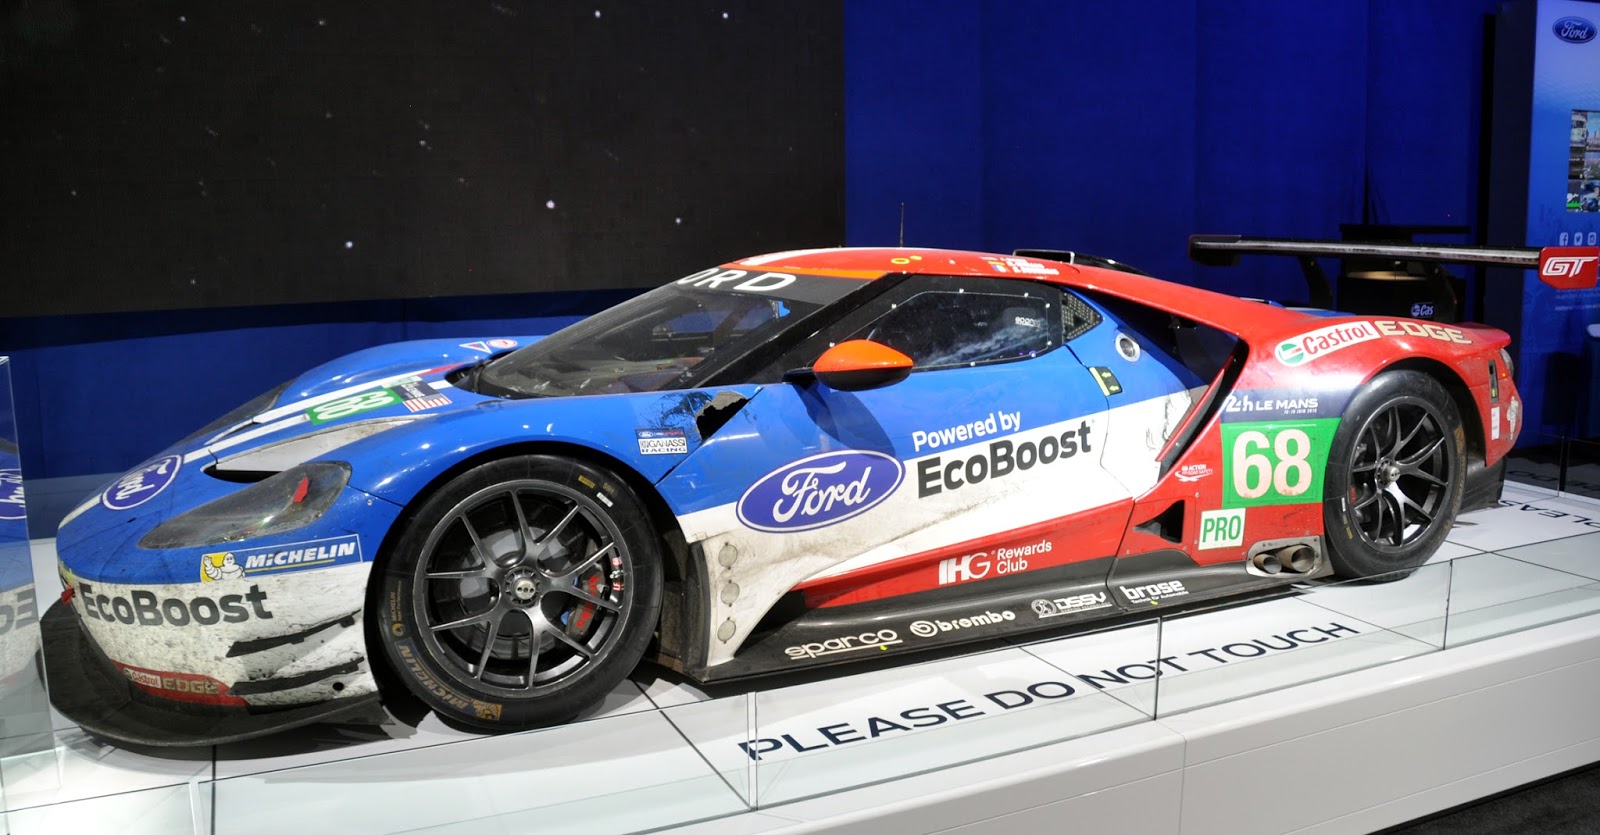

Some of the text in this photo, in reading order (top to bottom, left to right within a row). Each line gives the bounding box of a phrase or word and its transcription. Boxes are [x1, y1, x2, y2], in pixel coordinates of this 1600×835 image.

[1561, 20, 1588, 39] Ford
[1542, 256, 1598, 278] GT
[1302, 320, 1472, 355] Castrol EDGE
[1255, 400, 1275, 411] LE
[1276, 399, 1319, 410] MANS
[912, 411, 1021, 452] Powered by
[917, 420, 1093, 499] EcoBoost
[1233, 429, 1312, 498] 68
[772, 461, 873, 523] Ford
[1202, 515, 1242, 543] PRO
[245, 542, 356, 569] MICHELIN
[997, 539, 1052, 560] Rewards
[939, 552, 991, 585] IHG
[996, 557, 1028, 574] Club
[1053, 591, 1107, 610] DSSV
[1119, 580, 1185, 600] brose
[79, 582, 273, 626] EcoBoost
[935, 611, 1016, 631] brembo
[784, 629, 903, 660] sparco
[161, 677, 219, 694] EDGE
[738, 622, 1361, 761] PLEASE DO NOT TOUCH
